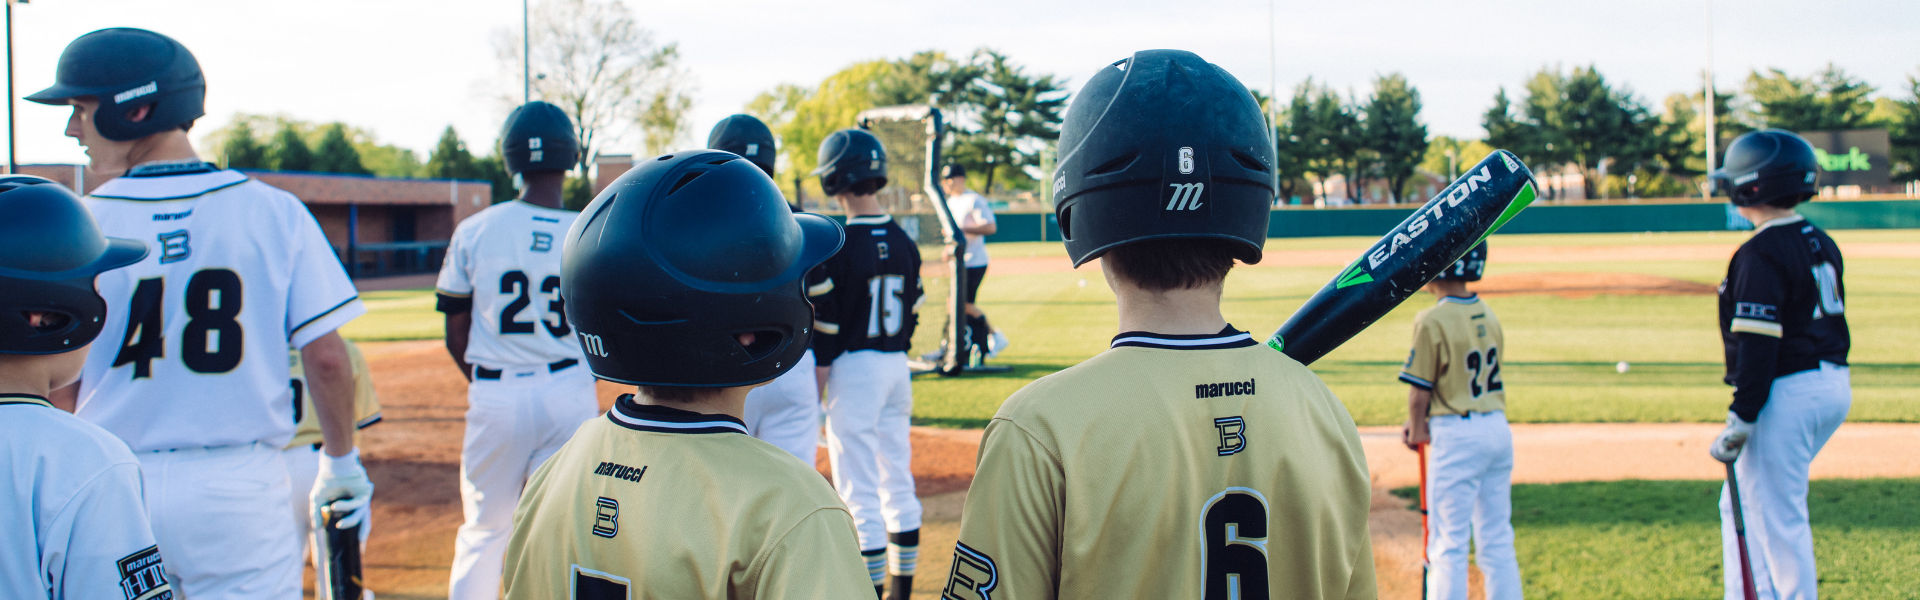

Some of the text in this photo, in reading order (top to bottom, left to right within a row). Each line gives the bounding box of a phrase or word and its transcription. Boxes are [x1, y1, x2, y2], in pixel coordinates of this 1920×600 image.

[1178, 146, 1194, 174] 6
[1368, 165, 1492, 271] EASTON
[157, 229, 192, 265] B
[530, 231, 554, 253] B
[111, 267, 245, 380] 48
[499, 269, 571, 338] 23
[866, 273, 905, 338] 15
[1195, 378, 1256, 399] marucci
[1465, 345, 1503, 399] 22
[1213, 415, 1247, 457] B
[593, 461, 648, 483] marucci
[592, 496, 620, 539] B
[1200, 486, 1270, 600] 6
